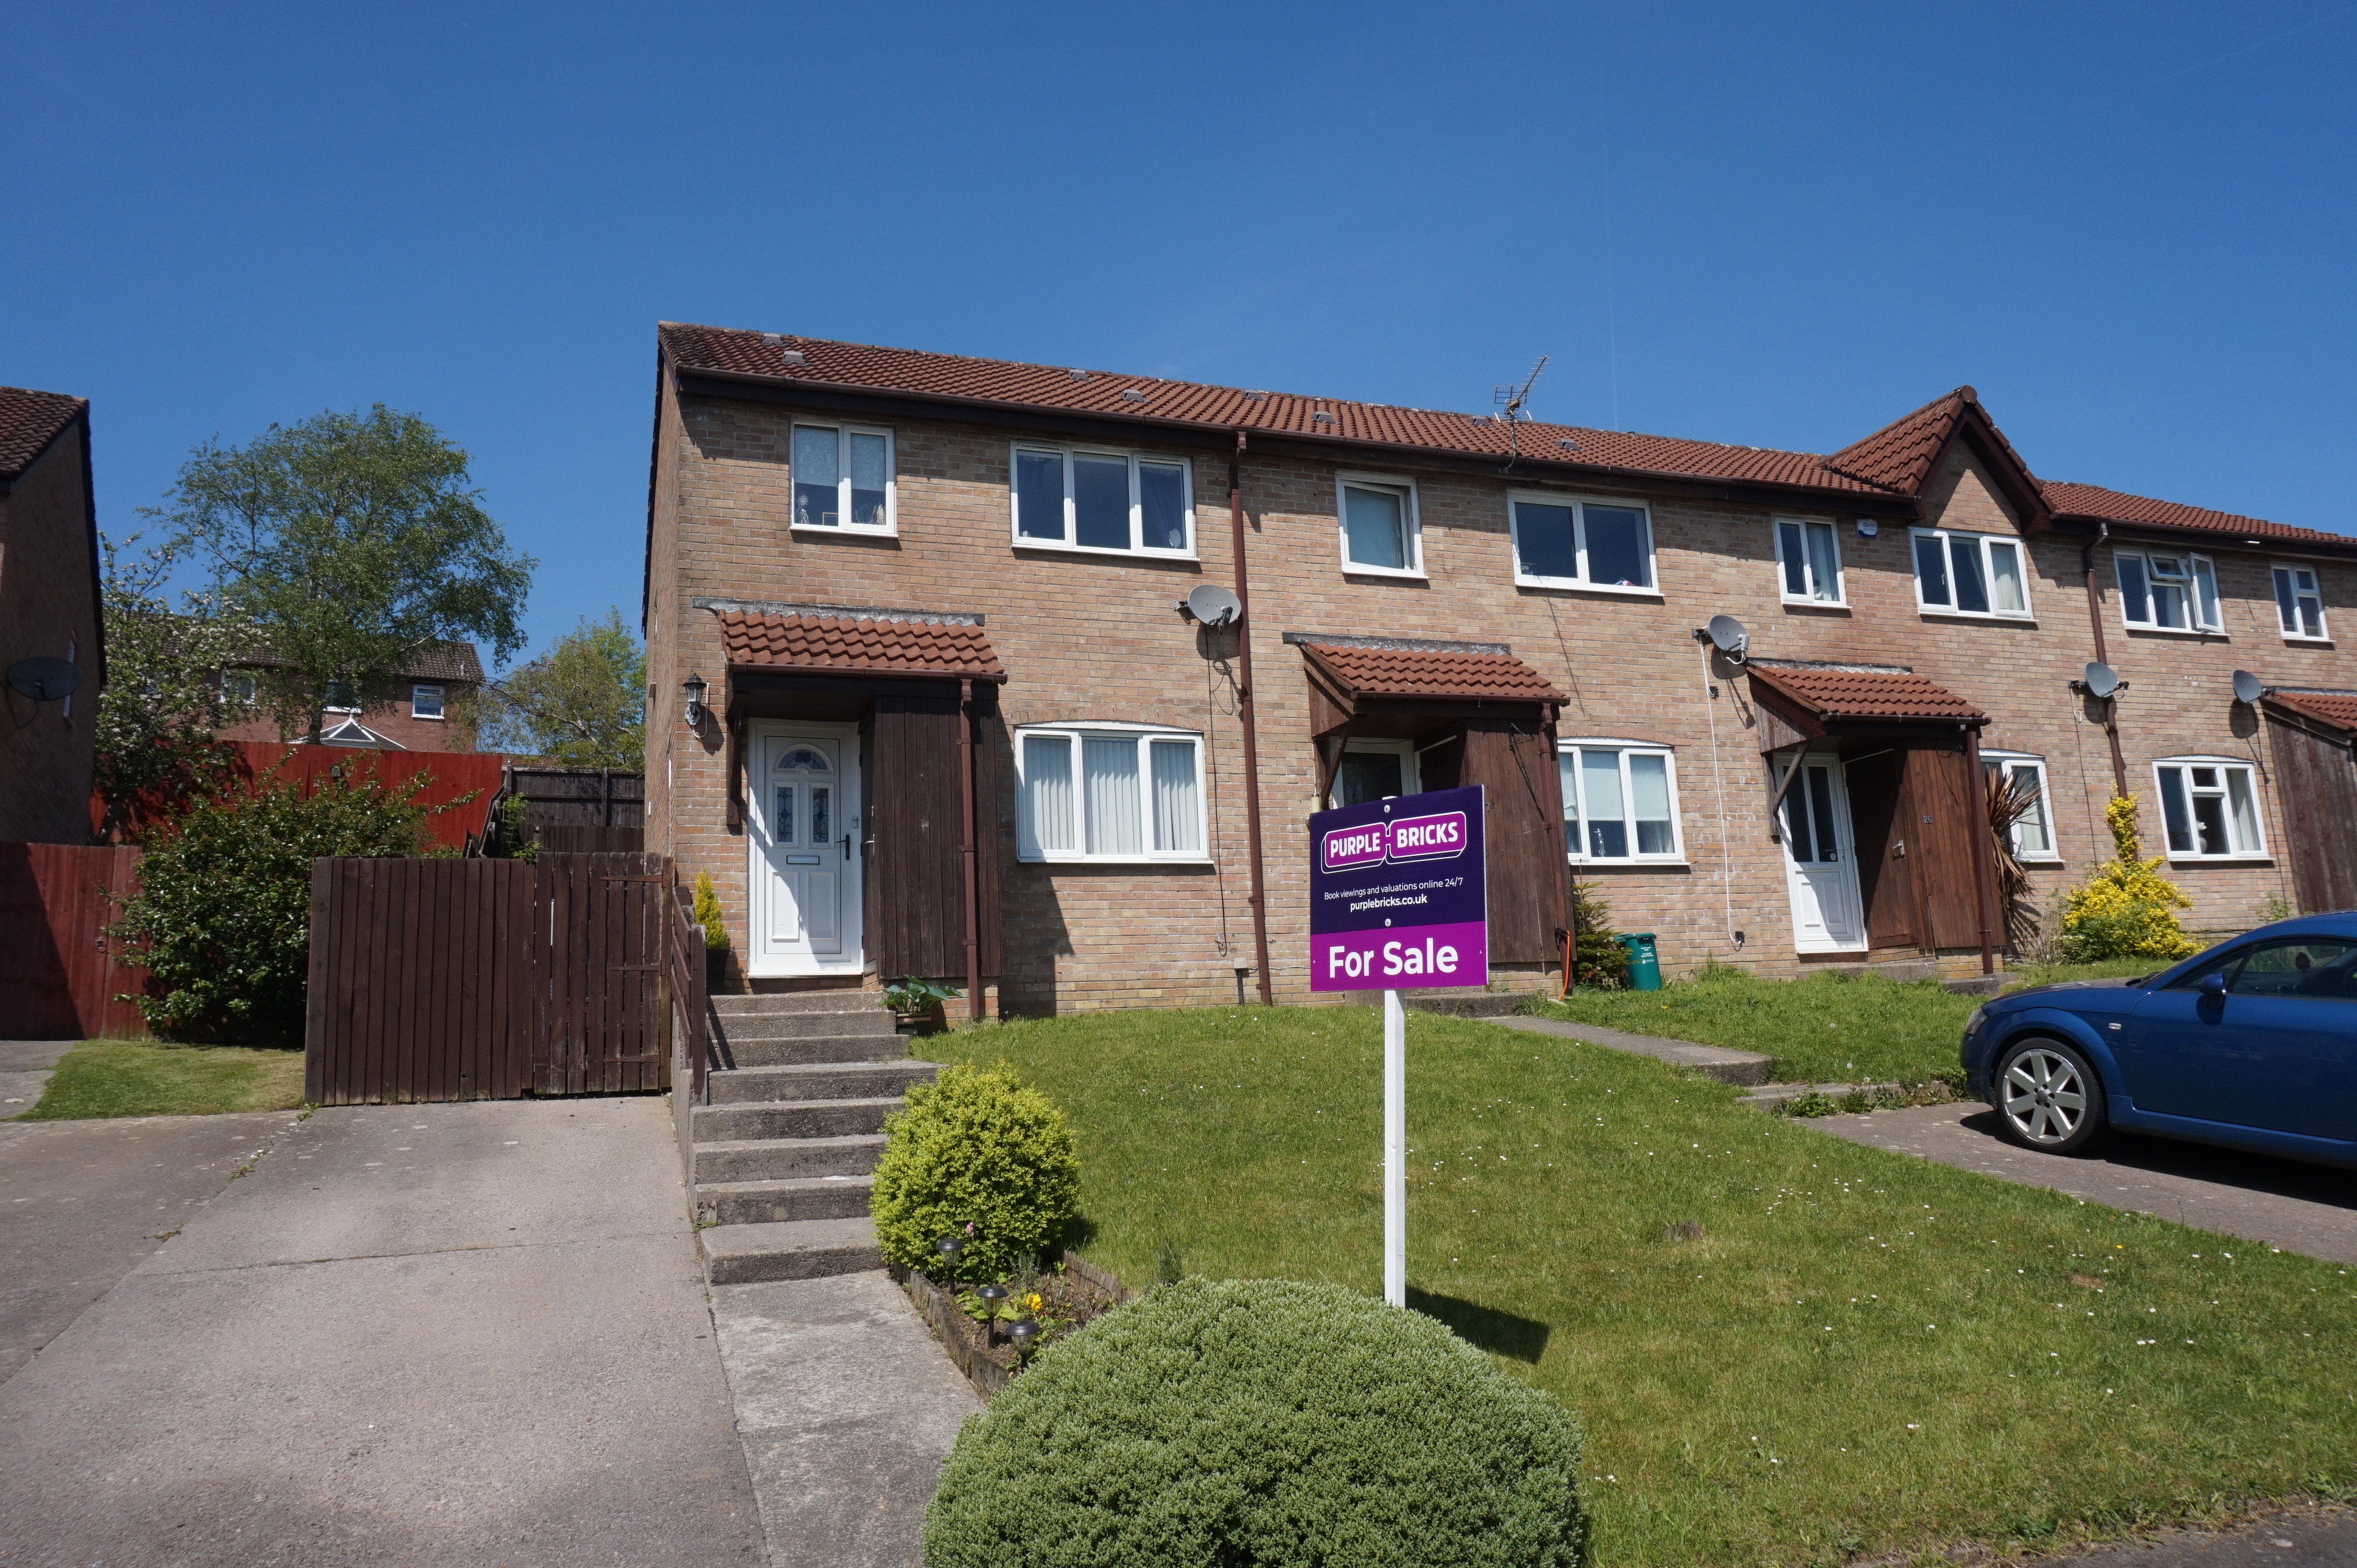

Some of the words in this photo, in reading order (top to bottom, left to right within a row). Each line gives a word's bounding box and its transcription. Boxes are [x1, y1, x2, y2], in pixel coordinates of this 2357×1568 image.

[1923, 815, 1933, 824] 26
[1330, 832, 1381, 858] PURPLE
[1396, 822, 1459, 848] BRICKS
[1324, 891, 1340, 900] Book
[1340, 888, 1366, 898] viewings
[1367, 885, 1379, 895] and
[1380, 883, 1418, 893] valuations
[1418, 880, 1443, 889] online
[1445, 876, 1463, 887] 24/7
[1350, 893, 1427, 913] purplebricks.co.uk
[1329, 945, 1374, 978] For
[1382, 937, 1459, 976] Sale
